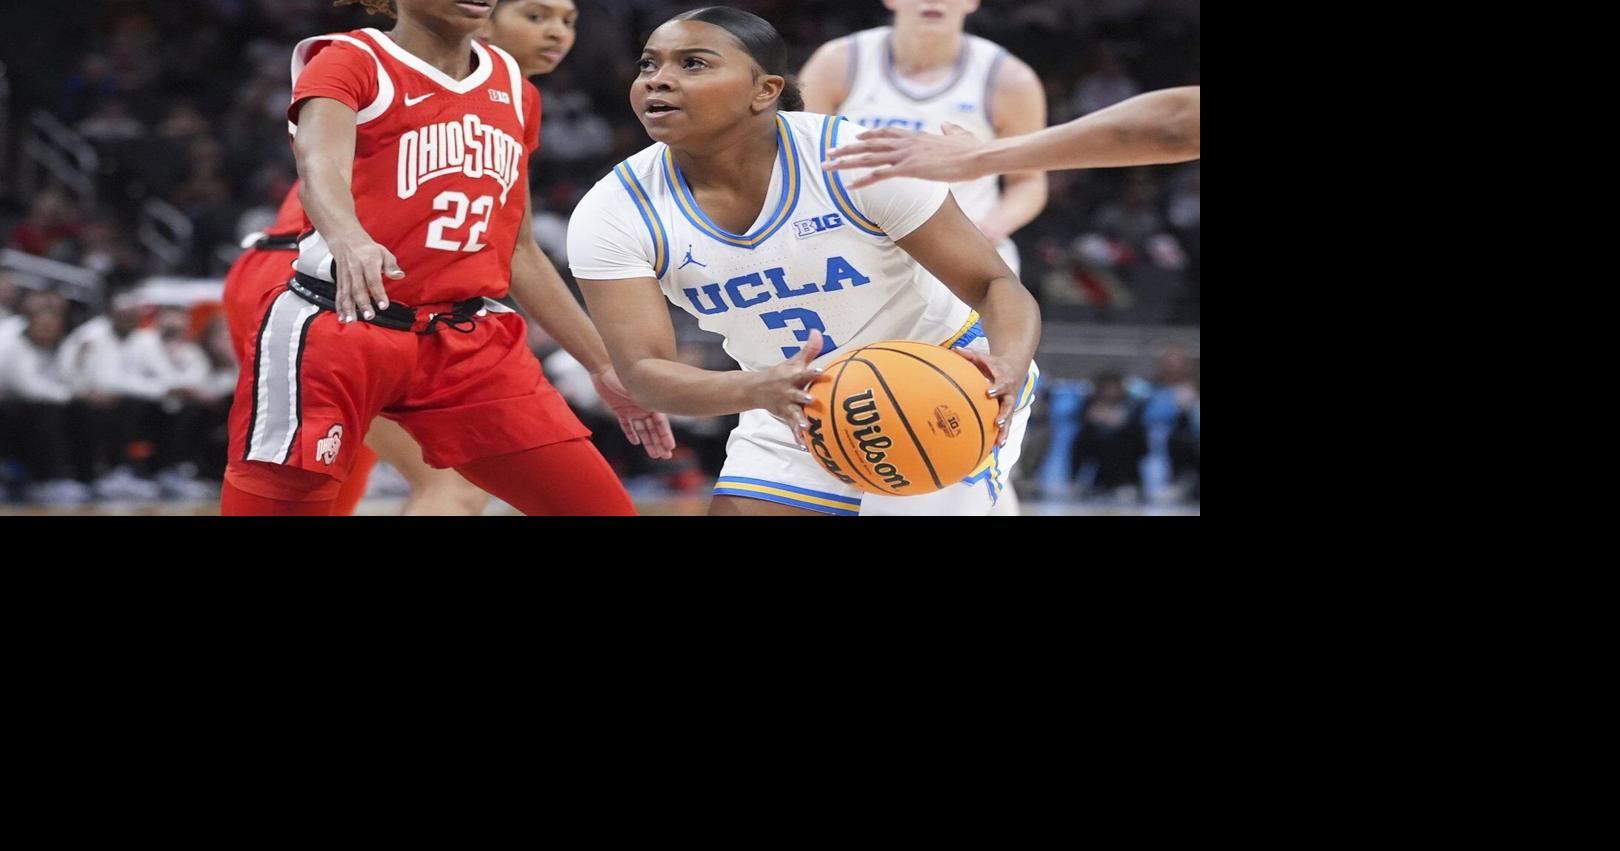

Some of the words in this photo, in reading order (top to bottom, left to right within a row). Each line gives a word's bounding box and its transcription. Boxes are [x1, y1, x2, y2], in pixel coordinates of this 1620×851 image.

[424, 190, 494, 252] 22
[683, 256, 871, 315] UCLA
[759, 307, 838, 359] 3
[842, 387, 912, 490] Wilson
